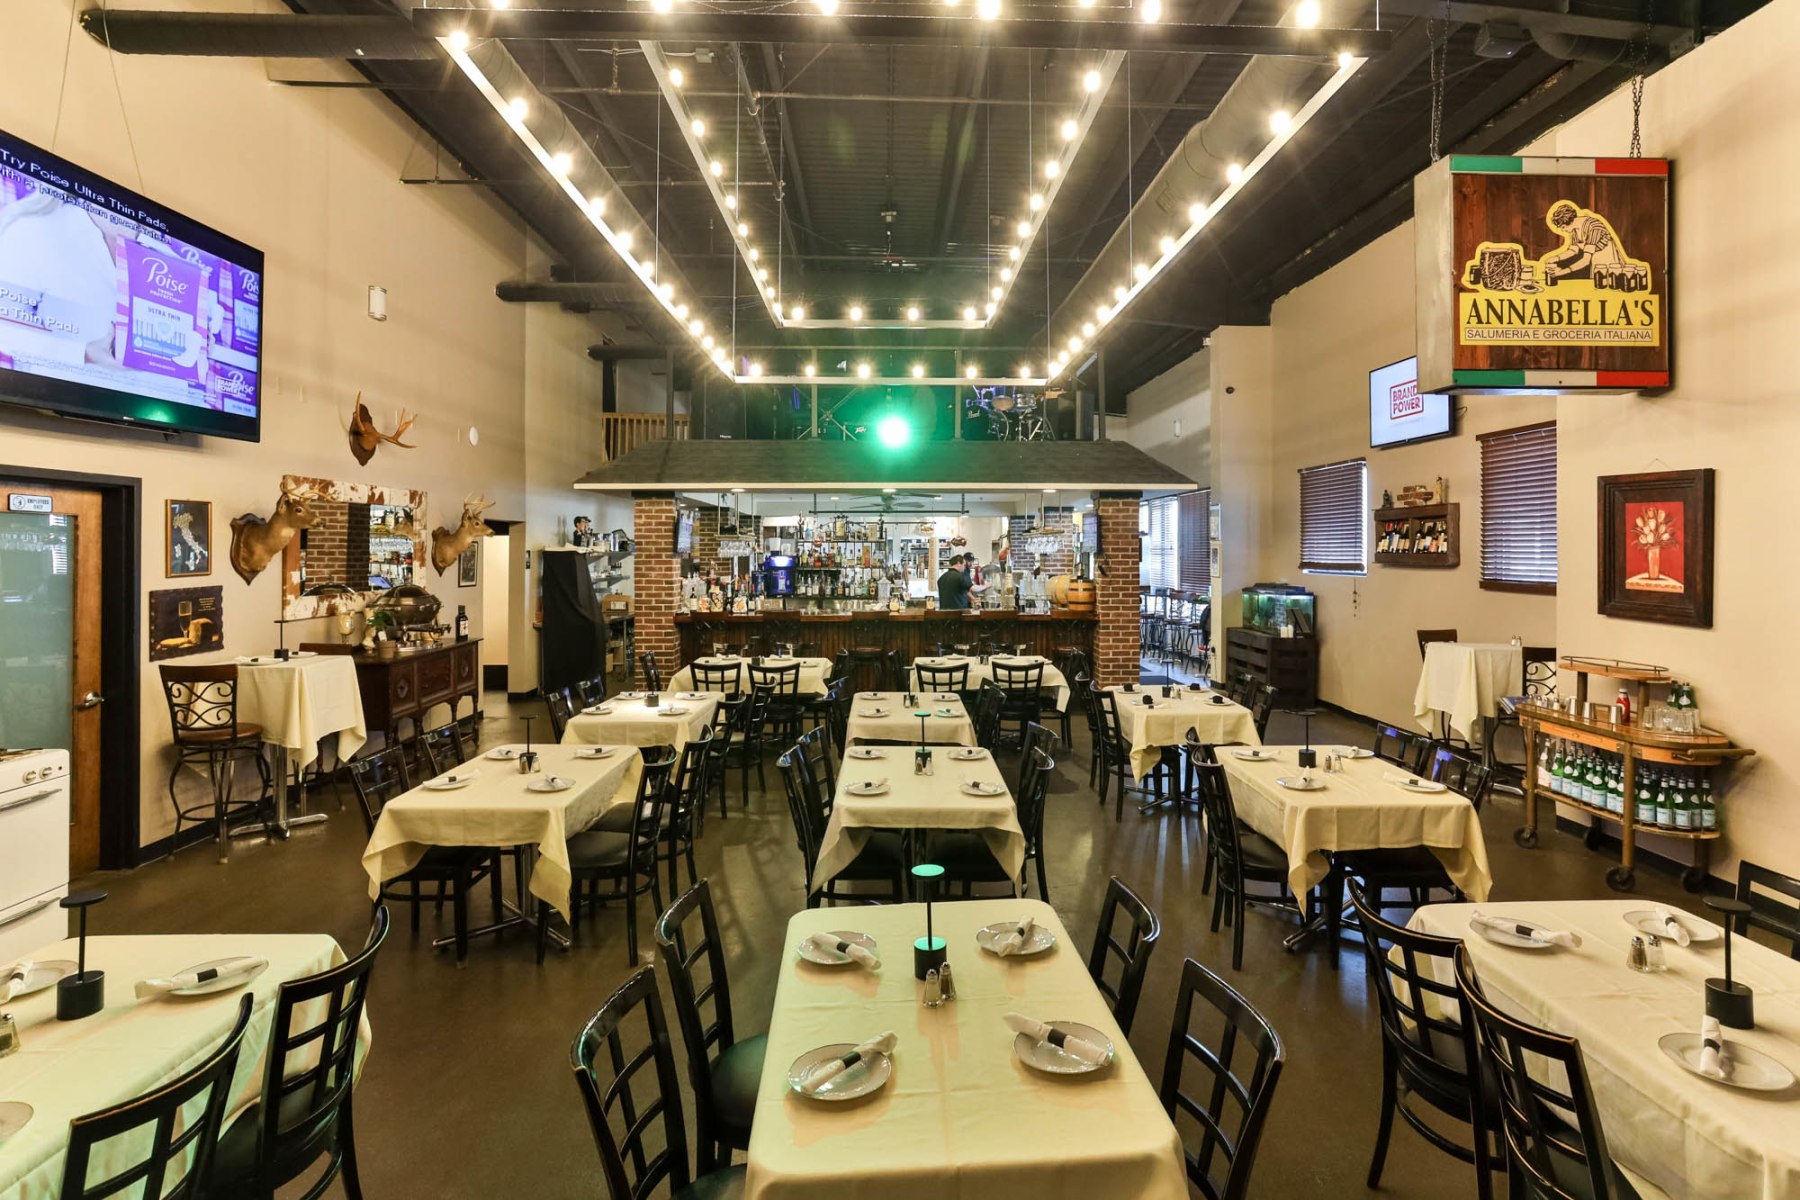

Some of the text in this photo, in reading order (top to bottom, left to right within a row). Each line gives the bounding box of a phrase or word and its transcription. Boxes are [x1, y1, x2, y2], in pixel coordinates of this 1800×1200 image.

[1, 149, 26, 168] Try
[30, 162, 70, 188] Poise
[74, 181, 105, 203] Ultra
[109, 196, 135, 217] Thin
[142, 256, 188, 294] Poise
[0, 287, 37, 307] Poise
[14, 308, 42, 324] Thin
[1466, 297, 1654, 327] ANNABELLA'S
[1467, 329, 1652, 340] SALUMERIA E GROCERIA ITALIANA
[1393, 397, 1420, 415] POWER
